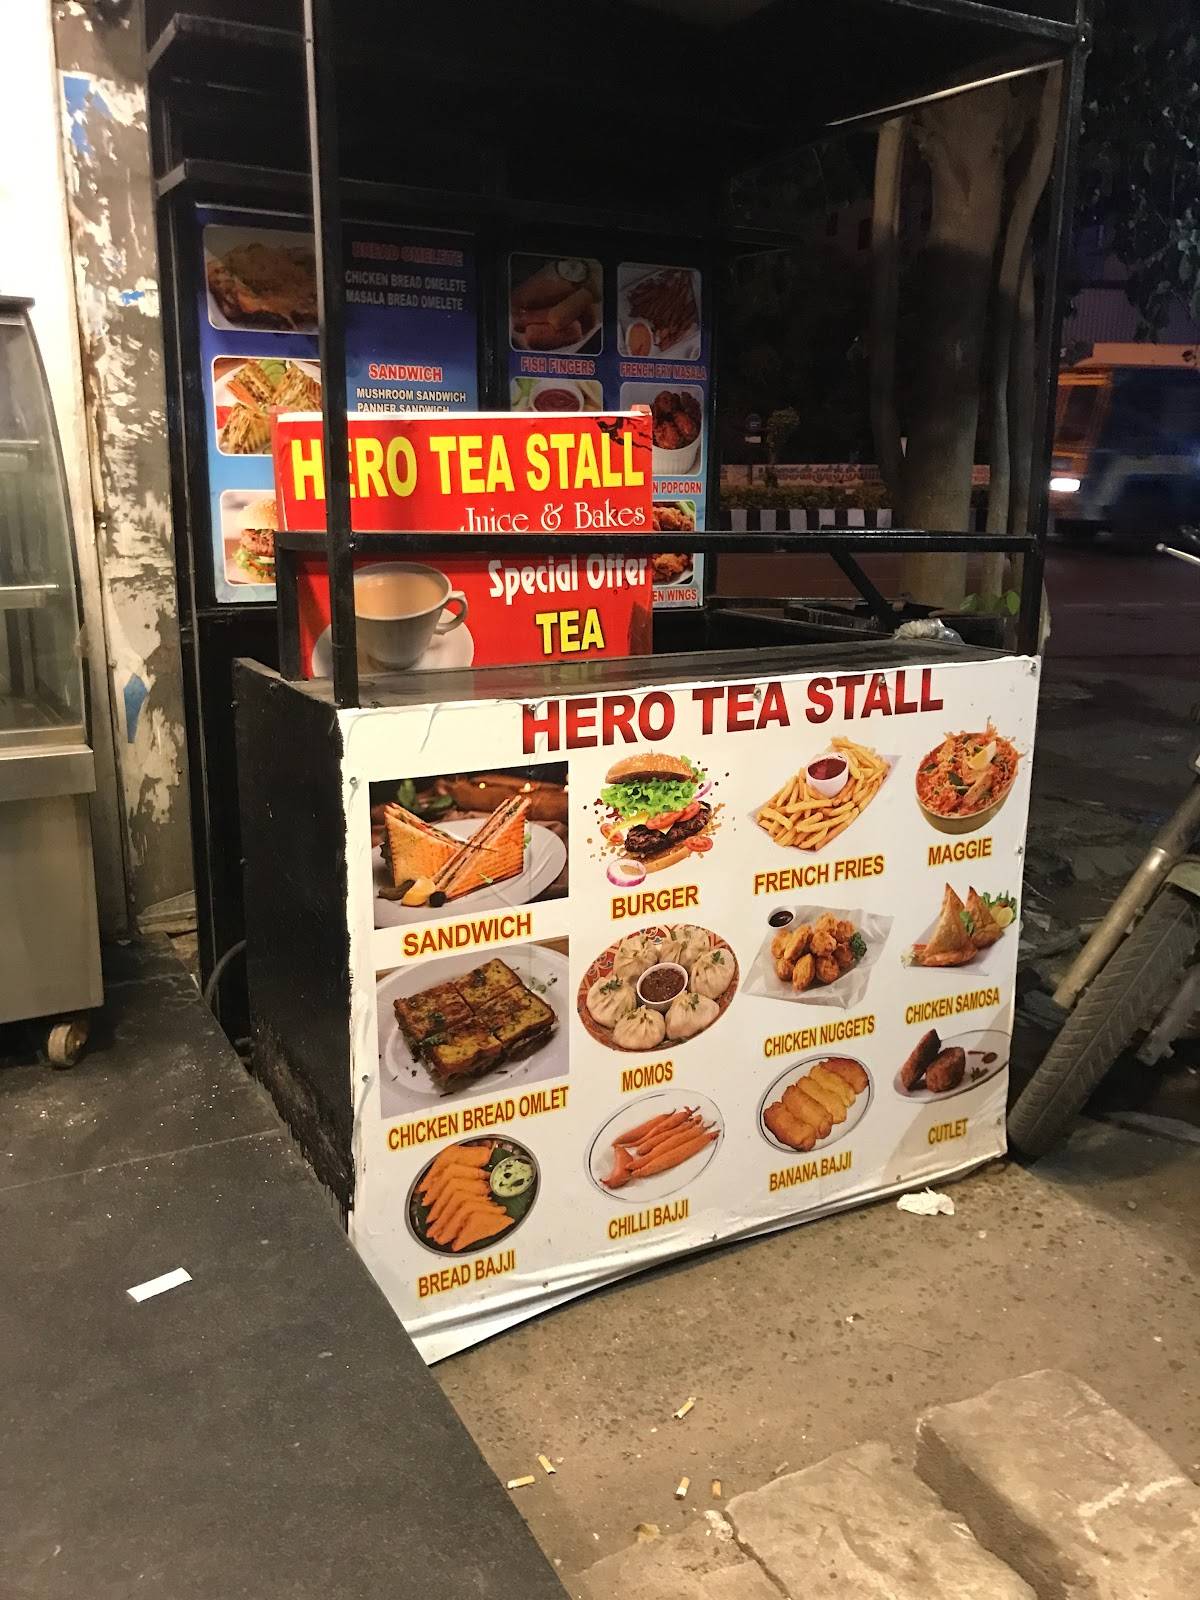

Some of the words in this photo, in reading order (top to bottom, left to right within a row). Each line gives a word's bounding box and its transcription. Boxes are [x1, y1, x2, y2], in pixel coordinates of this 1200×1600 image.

[345, 270, 389, 286] CHICKEN
[391, 274, 422, 289] BREAD
[424, 277, 467, 293] OMELETE
[346, 289, 385, 304] MASALA
[387, 292, 418, 307] BREAD
[421, 295, 463, 310] OMELETE
[368, 363, 443, 382] SANDWICH
[521, 356, 546, 373] FISH
[549, 358, 595, 375] FINGERS
[620, 362, 654, 377] FRENCH
[356, 388, 414, 400] MUSHROOM
[416, 391, 466, 402] SANDWICH
[357, 403, 396, 413] PANNER
[291, 436, 418, 501] HRO
[429, 435, 515, 495] TEA
[526, 432, 645, 491] STALL
[661, 481, 702, 494] POPCORN
[460, 507, 529, 532] Juice
[540, 503, 563, 531] &
[575, 498, 645, 529] Bakes
[488, 554, 578, 605] Special
[586, 553, 647, 590] Offer
[667, 589, 697, 601] WINGS
[535, 608, 605, 655] TEA
[522, 691, 675, 754] HERO
[692, 681, 790, 736] TEA
[806, 668, 943, 724] STALL
[928, 837, 992, 867] MAGGIE
[754, 864, 830, 895] FRENCH
[834, 855, 885, 882] FRIES
[611, 885, 699, 919] BURGER
[403, 913, 532, 957] SANDWICH
[906, 997, 953, 1025] CHICKEN
[955, 987, 1000, 1013] SAMOSA
[764, 1028, 817, 1057] CHICKEN
[820, 1015, 875, 1044] NUGGETS
[622, 1061, 673, 1092] MOMOS
[388, 1114, 459, 1150] CHICKEN
[463, 1099, 515, 1132] BREAD
[519, 1086, 569, 1117] OMLET
[928, 1118, 968, 1144] CUTLET
[769, 1161, 818, 1192] BANANA
[821, 1151, 852, 1177] BAJJI
[608, 1214, 650, 1240] CHILLI
[653, 1200, 689, 1228] BAJJI
[418, 1264, 471, 1297] BREAD
[475, 1250, 515, 1280] BAJJI
